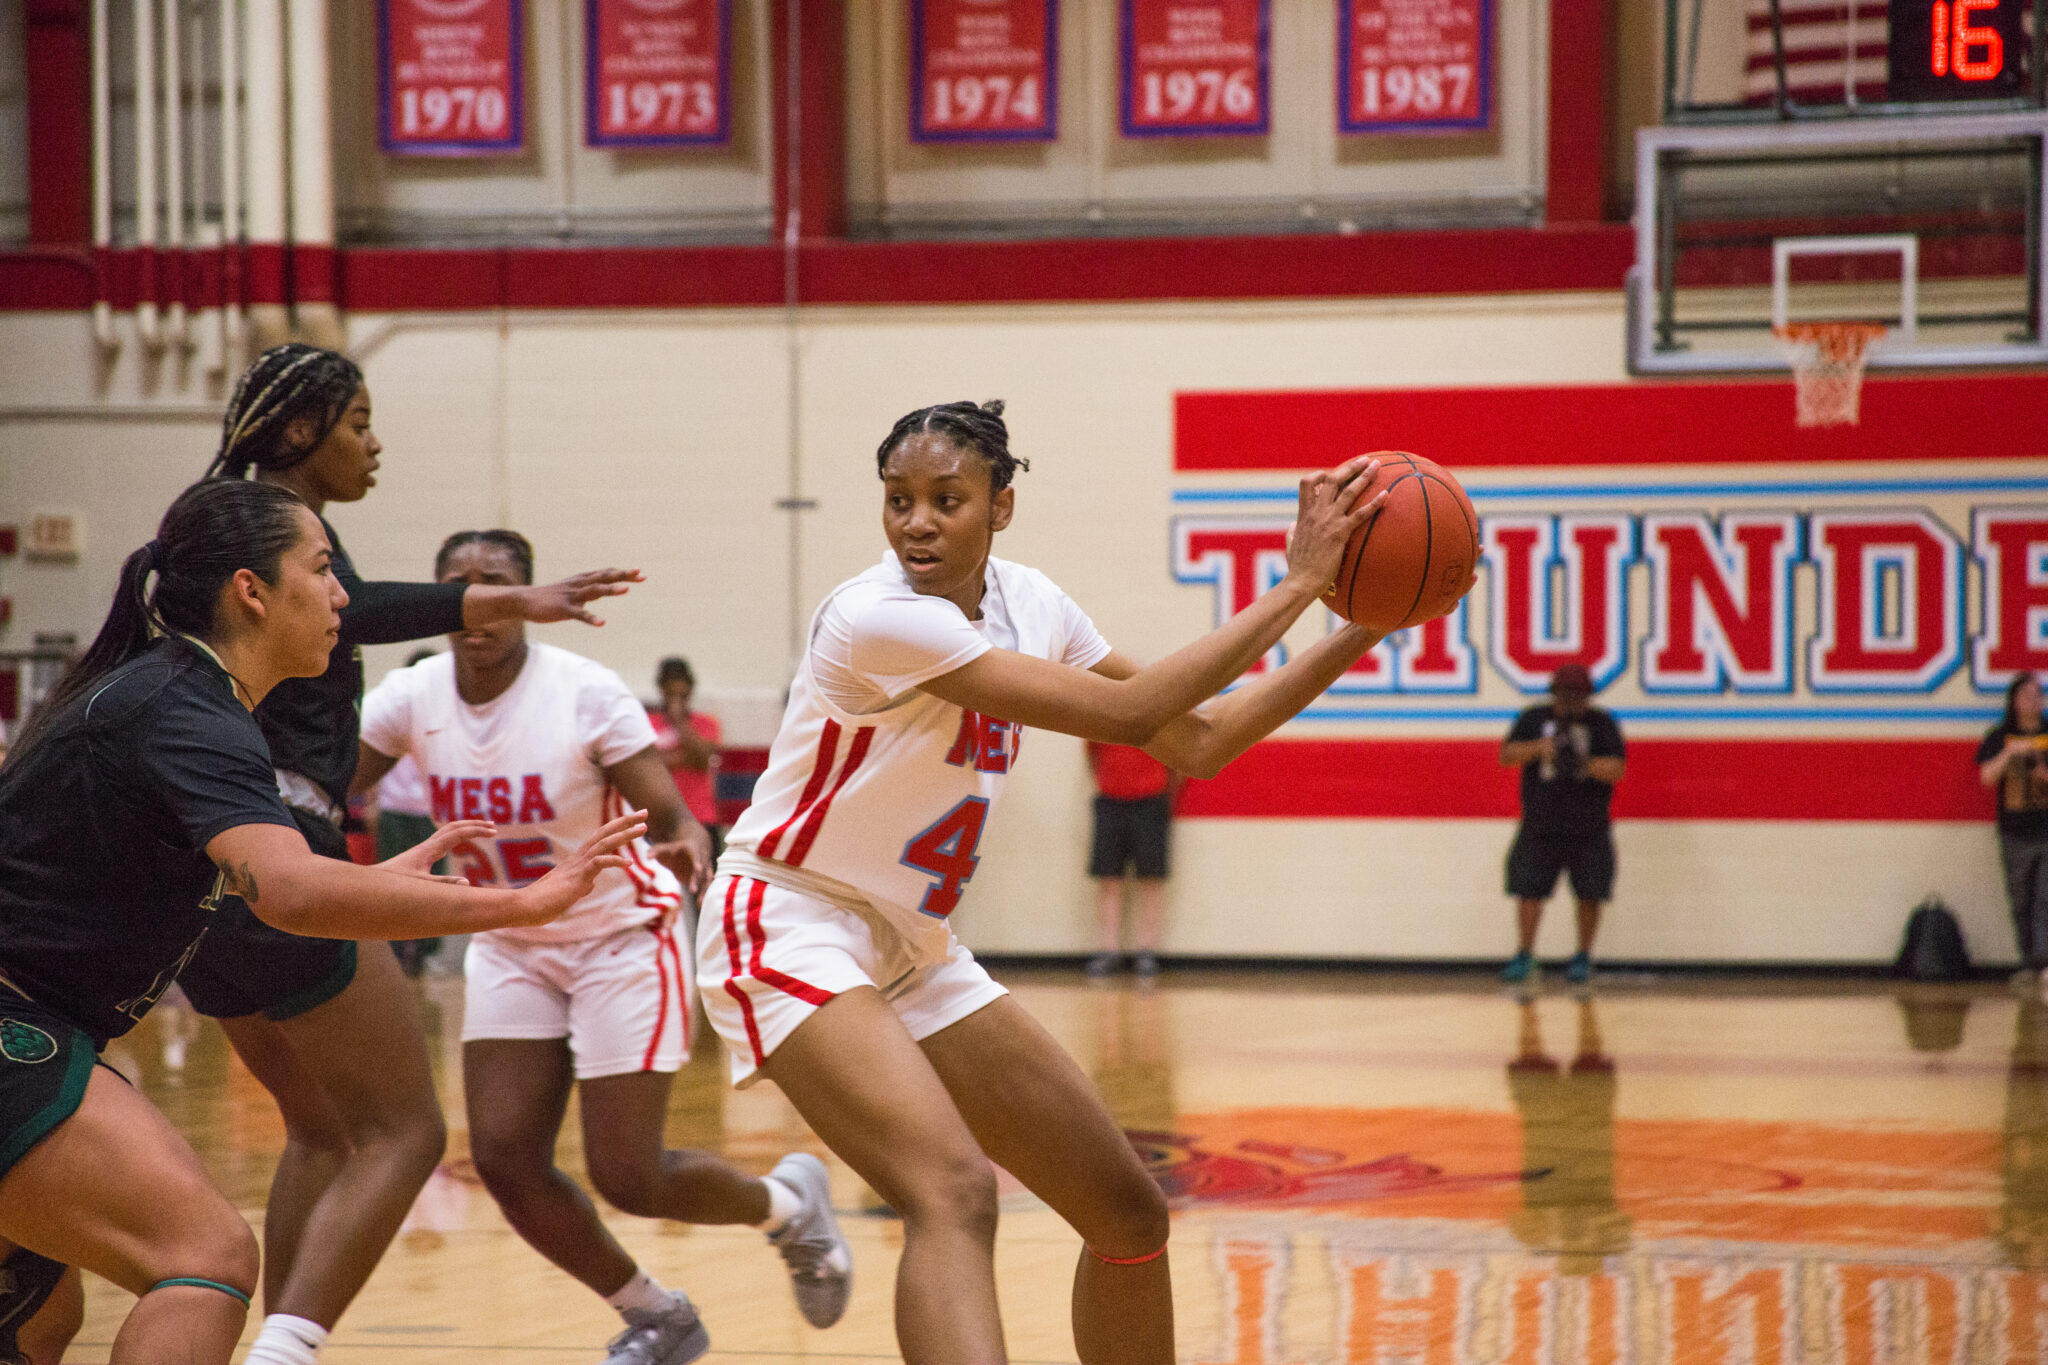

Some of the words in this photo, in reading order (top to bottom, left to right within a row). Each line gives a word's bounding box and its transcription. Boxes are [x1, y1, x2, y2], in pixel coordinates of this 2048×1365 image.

[1931, 0, 2004, 81] 16
[401, 86, 506, 134] 1970
[609, 81, 716, 129] 1973
[933, 75, 1038, 123] 1974
[1144, 70, 1254, 119] 1976
[1362, 63, 1472, 114] 1987
[428, 772, 556, 825] MESA
[899, 794, 990, 920] 4
